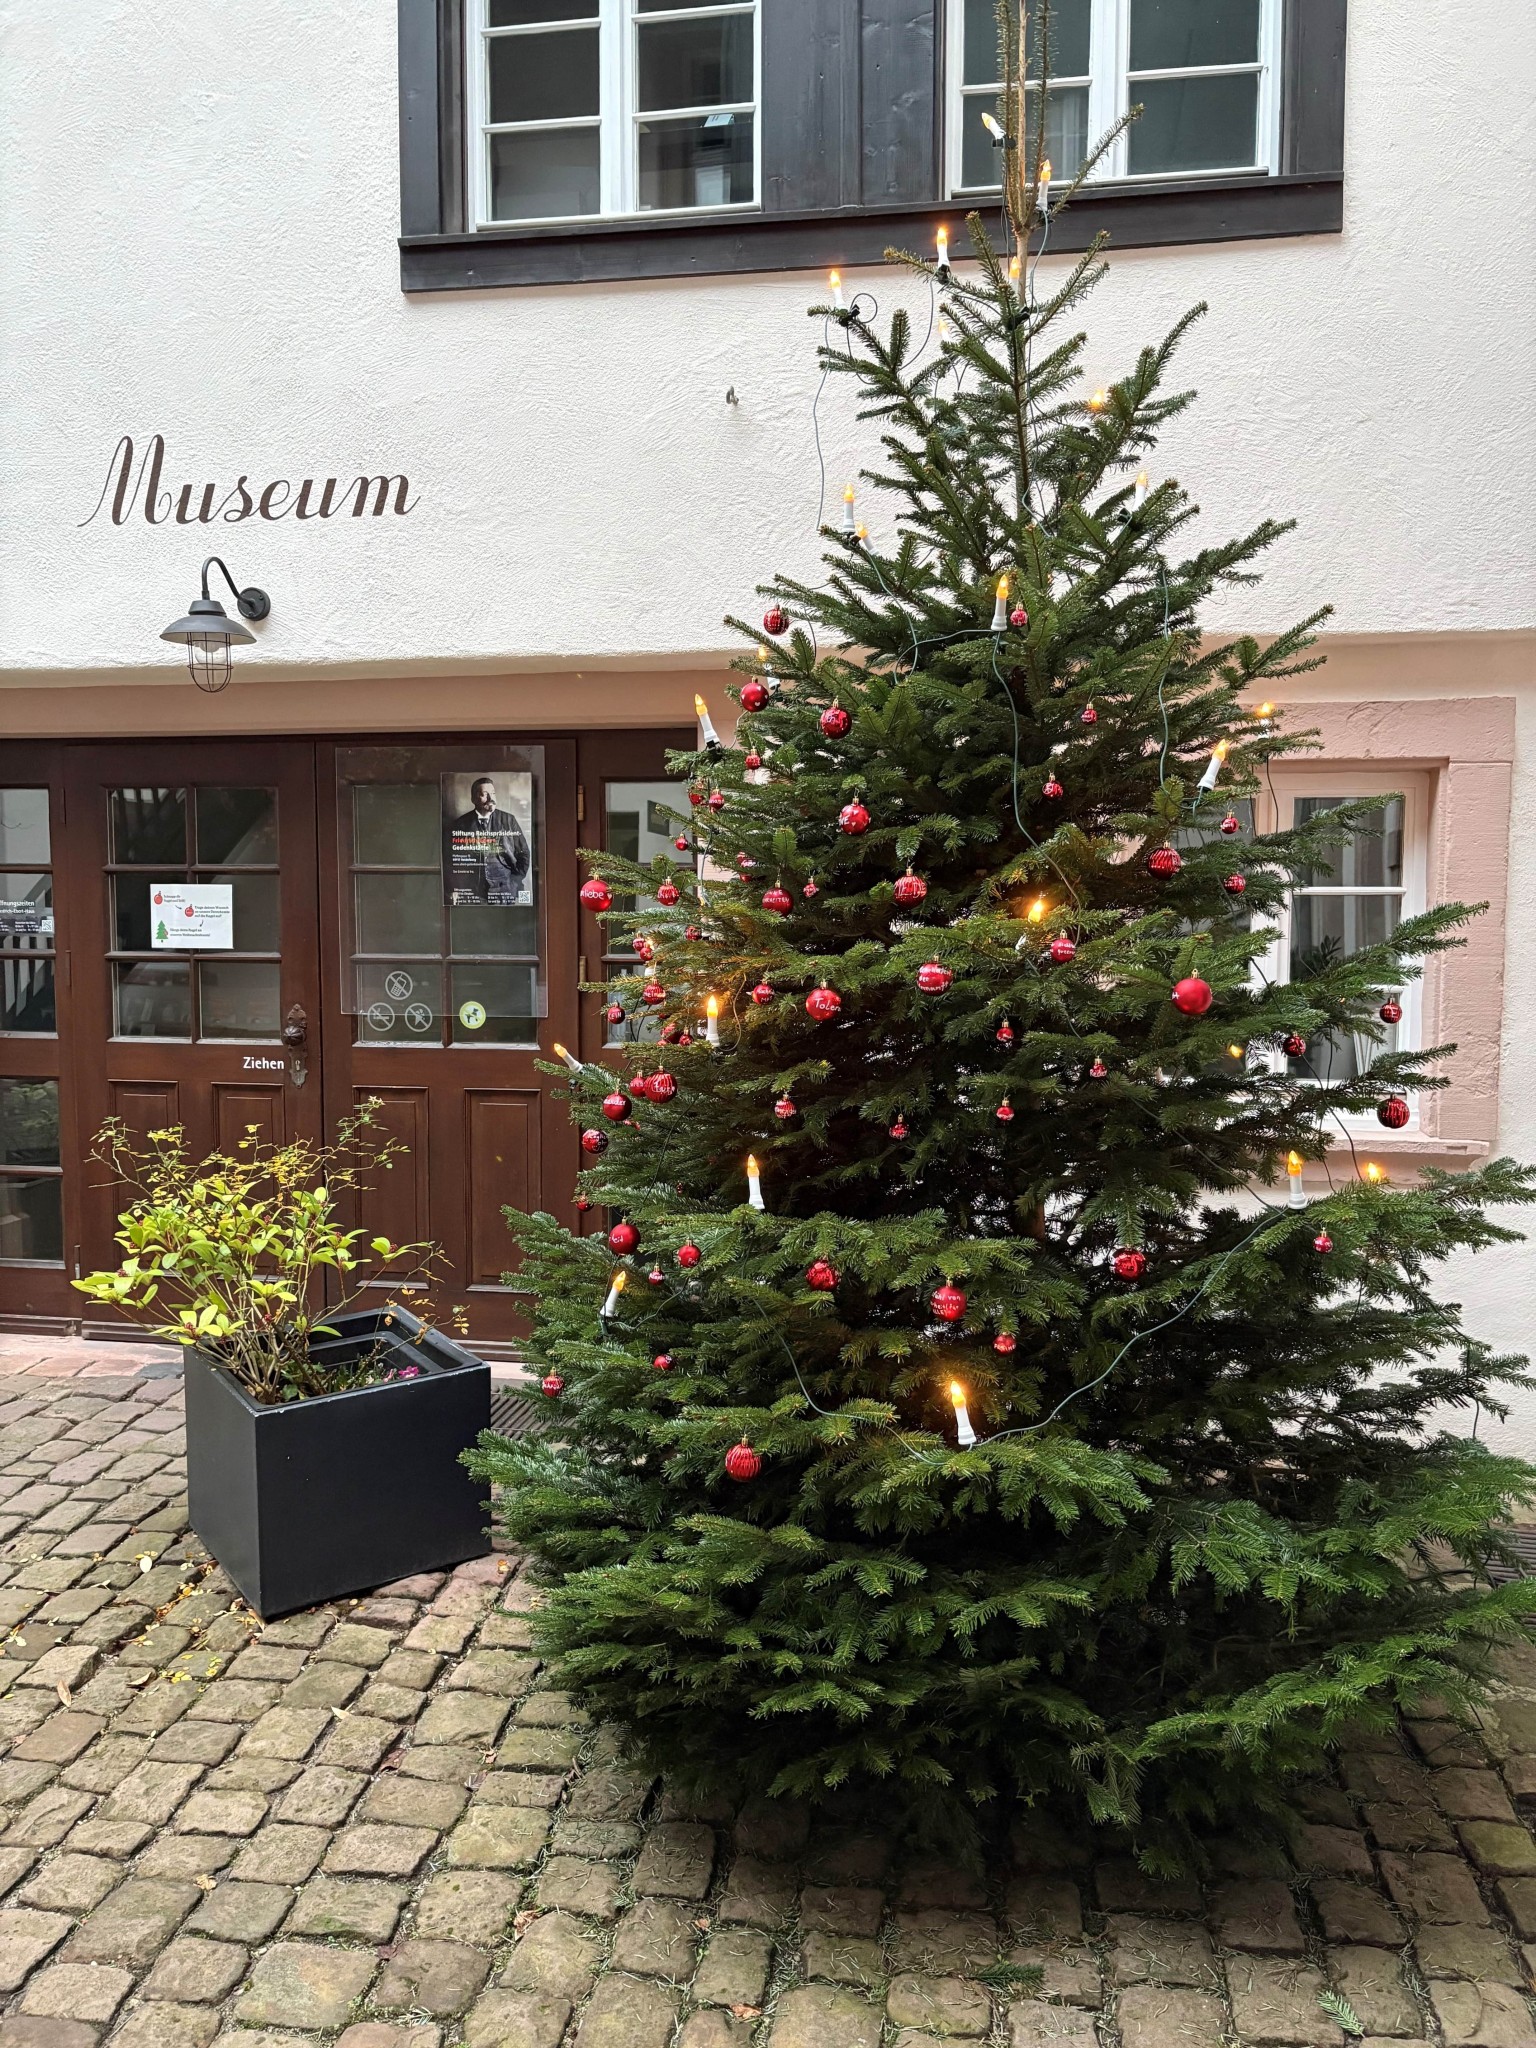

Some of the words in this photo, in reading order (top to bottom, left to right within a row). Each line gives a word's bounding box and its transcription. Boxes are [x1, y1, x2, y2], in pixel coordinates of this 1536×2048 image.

[77, 434, 421, 527] Museum
[452, 830, 475, 838] Stiftung
[243, 1056, 285, 1070] Ziehen
